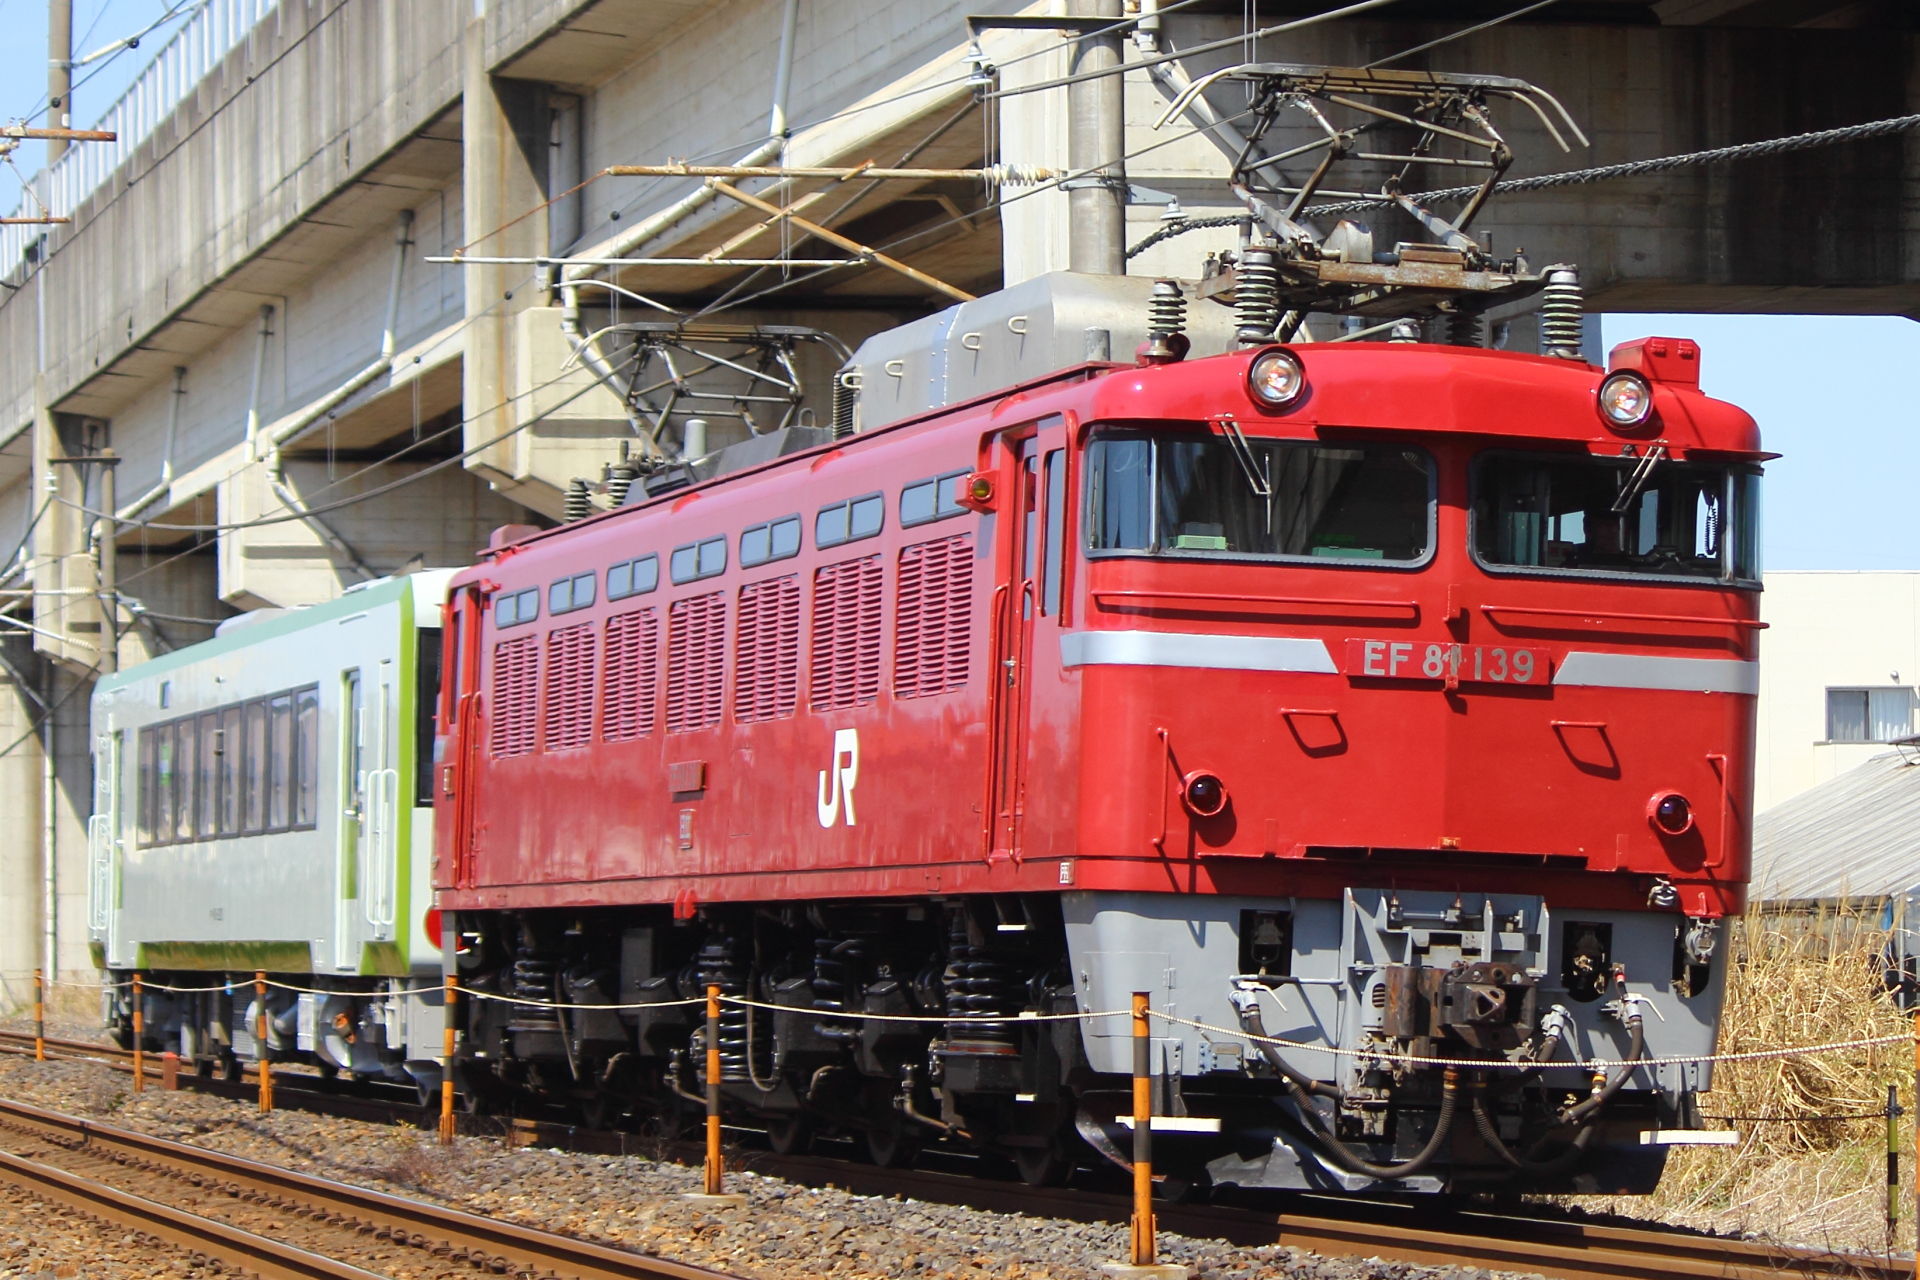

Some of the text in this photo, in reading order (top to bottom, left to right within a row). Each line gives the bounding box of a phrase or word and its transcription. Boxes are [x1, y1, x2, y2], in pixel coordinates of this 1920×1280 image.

[1364, 641, 1534, 682] EF 81 139
[818, 727, 859, 828] JR
